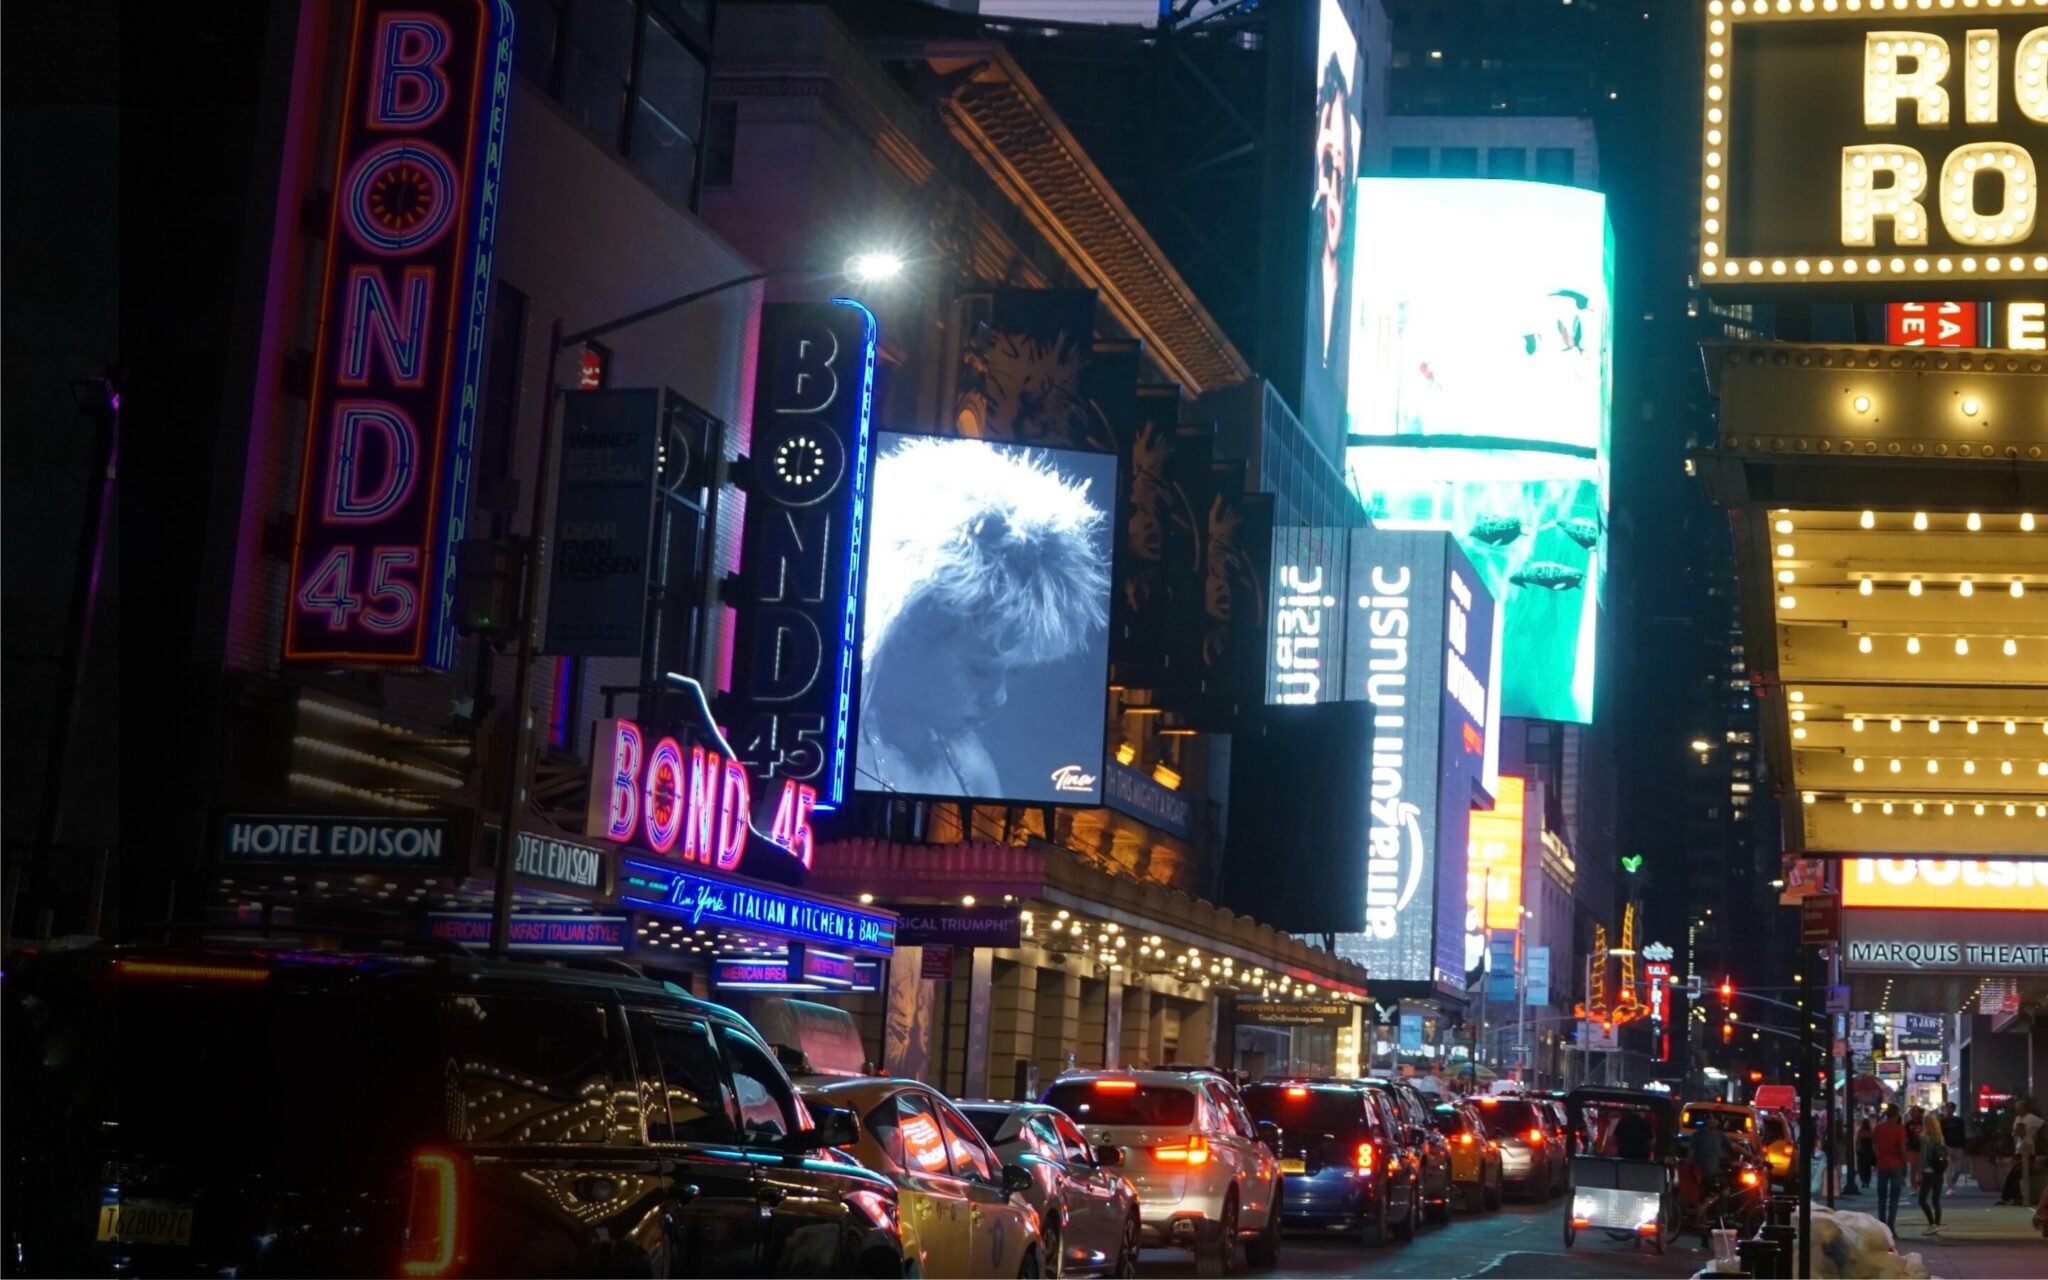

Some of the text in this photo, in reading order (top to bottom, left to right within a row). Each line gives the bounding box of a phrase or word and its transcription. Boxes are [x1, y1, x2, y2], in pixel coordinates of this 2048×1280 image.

[322, 10, 461, 524] BOND
[443, 37, 509, 619] BREAKFAST ALL DAY
[300, 545, 421, 632] 45
[1357, 565, 1412, 729] music
[607, 718, 818, 872] BOND 45
[231, 823, 442, 858] HOTEL EDISON
[546, 841, 600, 887] EDISON
[432, 920, 486, 938] AMERICAN
[547, 923, 586, 941] ITALIAN
[586, 924, 619, 942] STYLE
[692, 885, 727, 924] York
[733, 892, 785, 925] ITALIAN
[790, 907, 844, 936] KITCHEN
[847, 918, 855, 940] &
[859, 919, 879, 943] BAR
[898, 916, 938, 931] SICAL
[720, 966, 764, 980] AMERICAN
[855, 969, 870, 984] YLE
[1852, 943, 1959, 966] MARQUIS
[1300, 1005, 1336, 1015] OCTOBER
